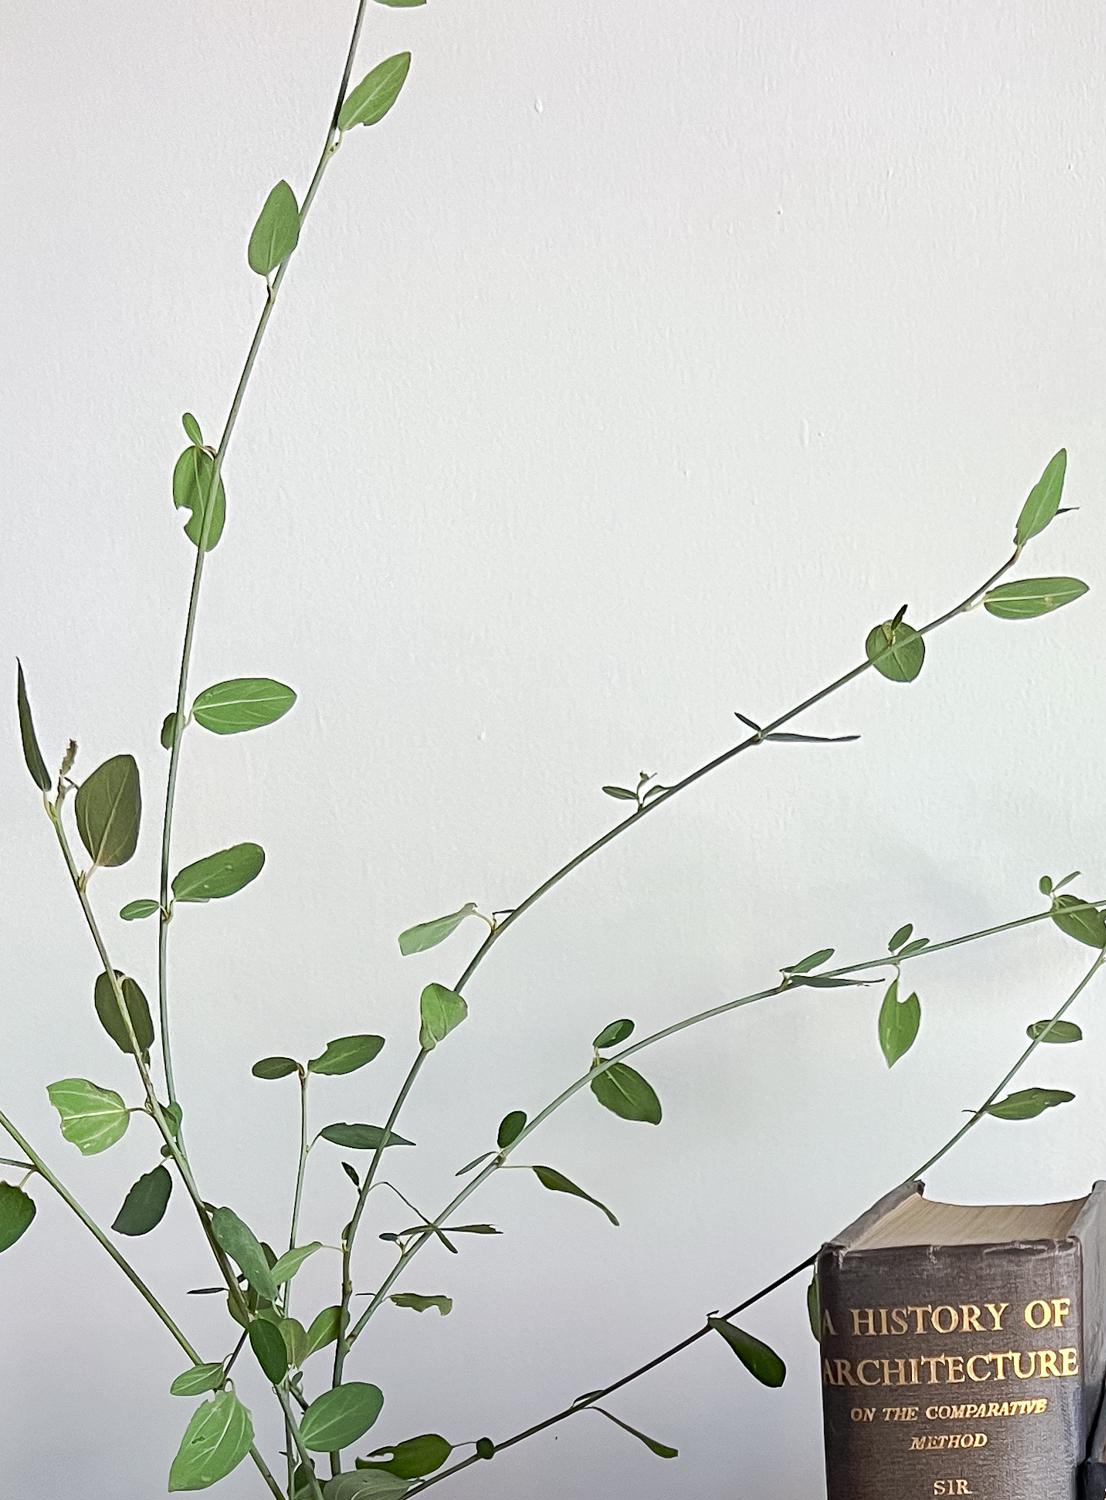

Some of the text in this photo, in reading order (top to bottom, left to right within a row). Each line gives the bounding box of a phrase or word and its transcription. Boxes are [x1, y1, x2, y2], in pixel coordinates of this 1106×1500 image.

[822, 1298, 1071, 1337] A HISTORY OF
[823, 1347, 1079, 1387] ARCHITECTURE
[851, 1399, 1048, 1422] ON THE COMPARATIVE
[910, 1433, 988, 1450] METHOD
[933, 1479, 973, 1496] SIR
